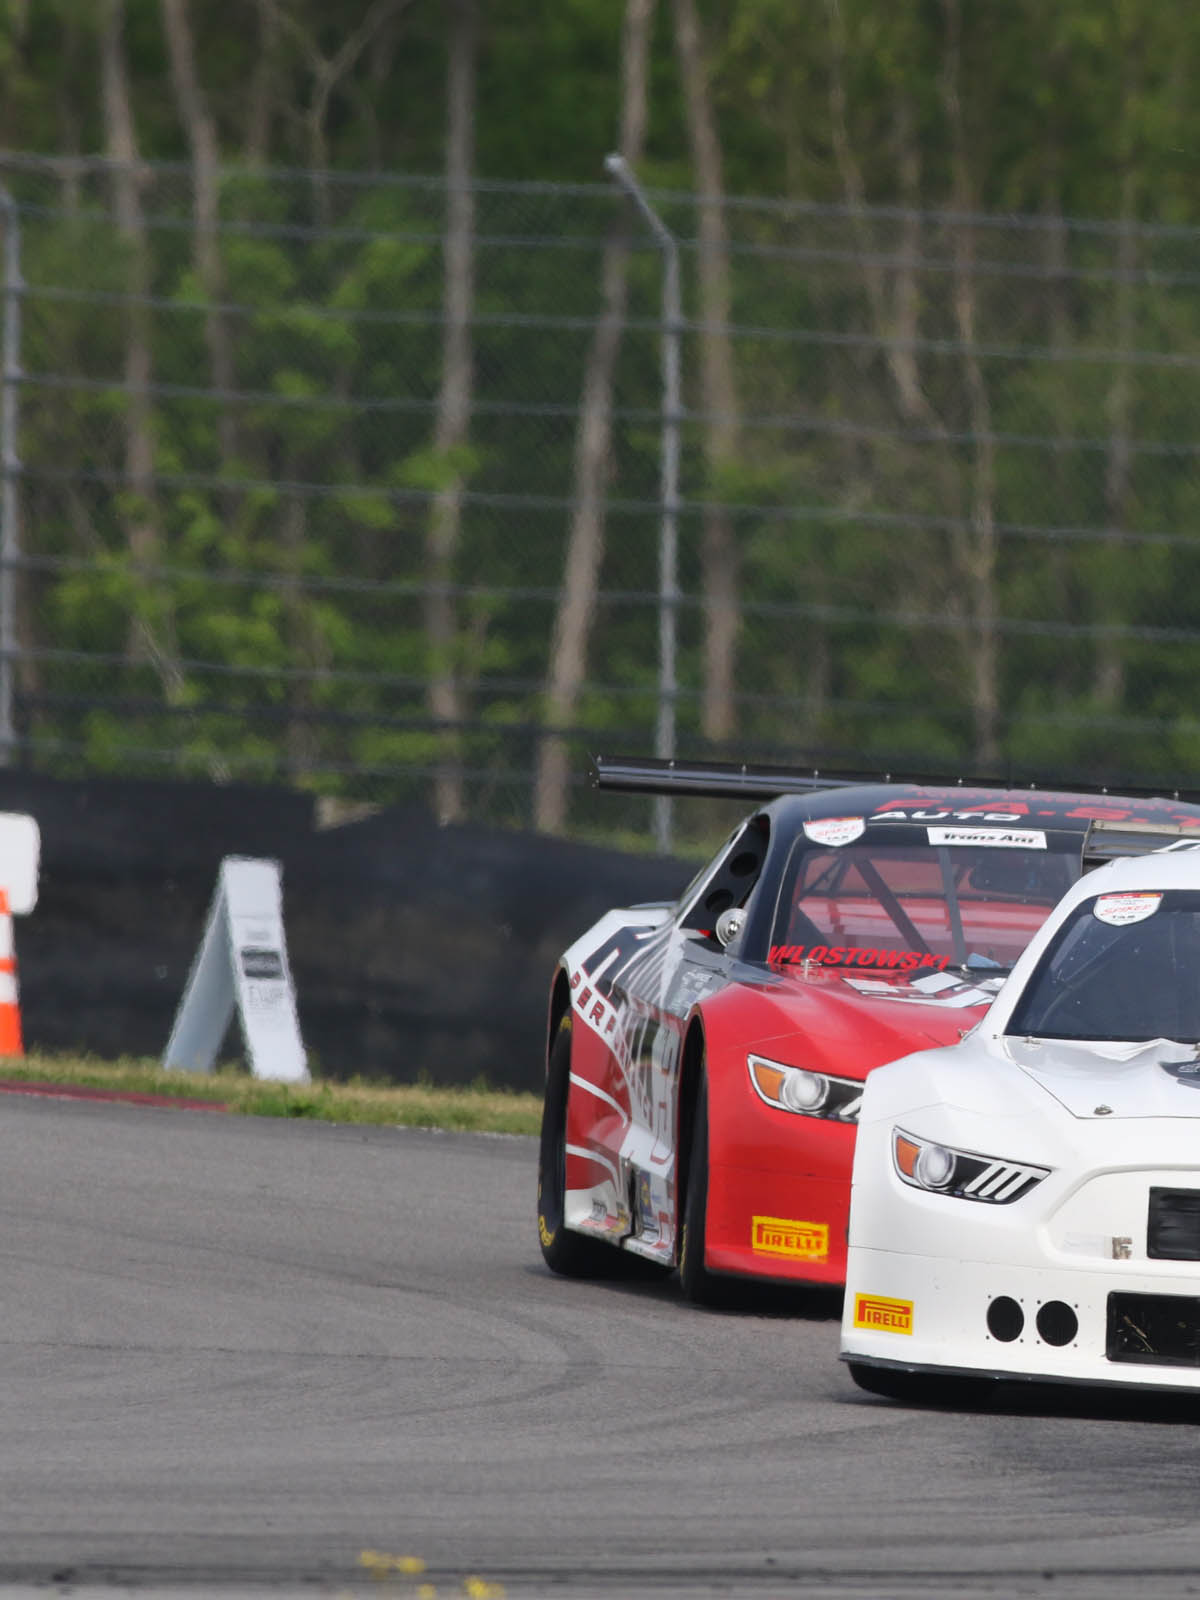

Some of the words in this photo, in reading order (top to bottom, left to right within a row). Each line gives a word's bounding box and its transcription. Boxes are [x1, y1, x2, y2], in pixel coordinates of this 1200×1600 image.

[868, 811, 1021, 822] AUTO
[767, 945, 951, 971] WLOSTOWSKI
[756, 1223, 823, 1251] PIRELLI
[857, 1299, 911, 1329] PIRELLI
